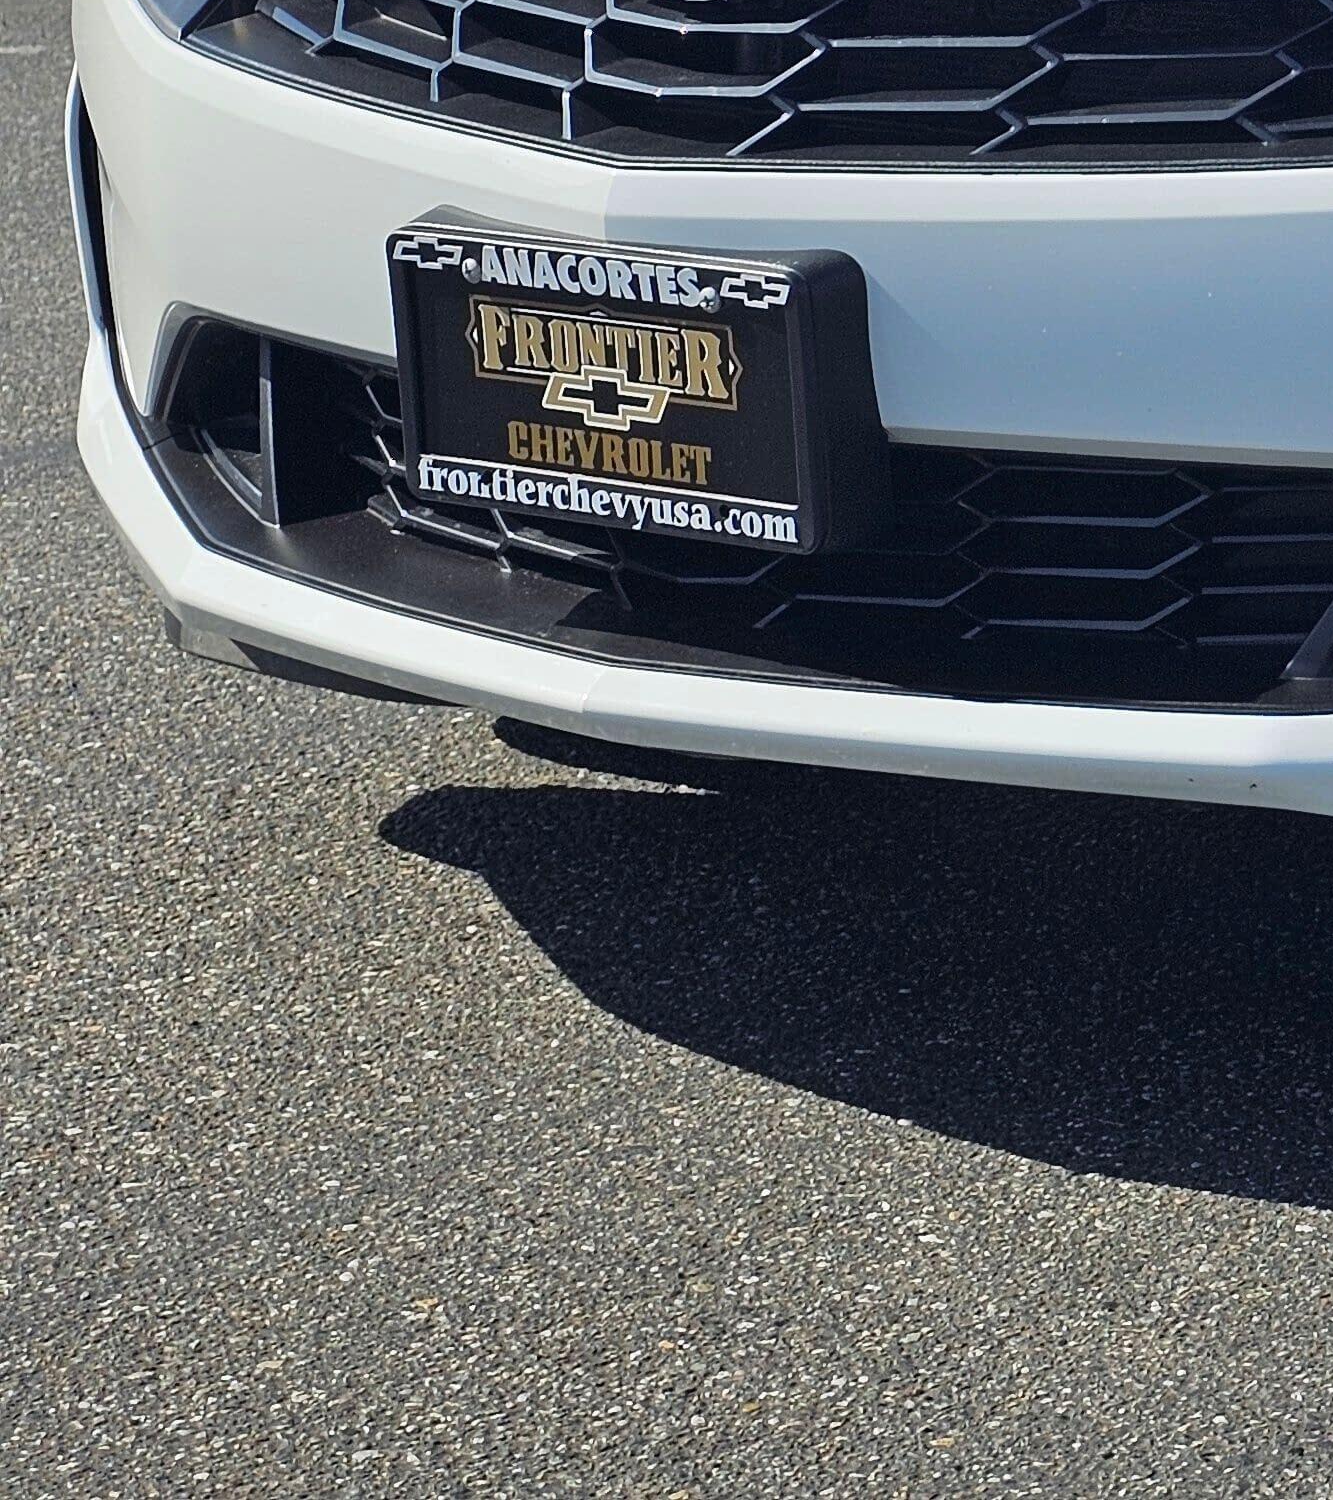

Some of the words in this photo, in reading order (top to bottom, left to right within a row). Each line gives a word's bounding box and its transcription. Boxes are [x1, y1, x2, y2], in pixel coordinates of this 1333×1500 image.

[481, 245, 701, 308] ANACORTES
[477, 302, 730, 401] FRONTIER
[507, 420, 713, 487] CHEVROLET
[418, 455, 799, 545] frontierchevyusa.com
